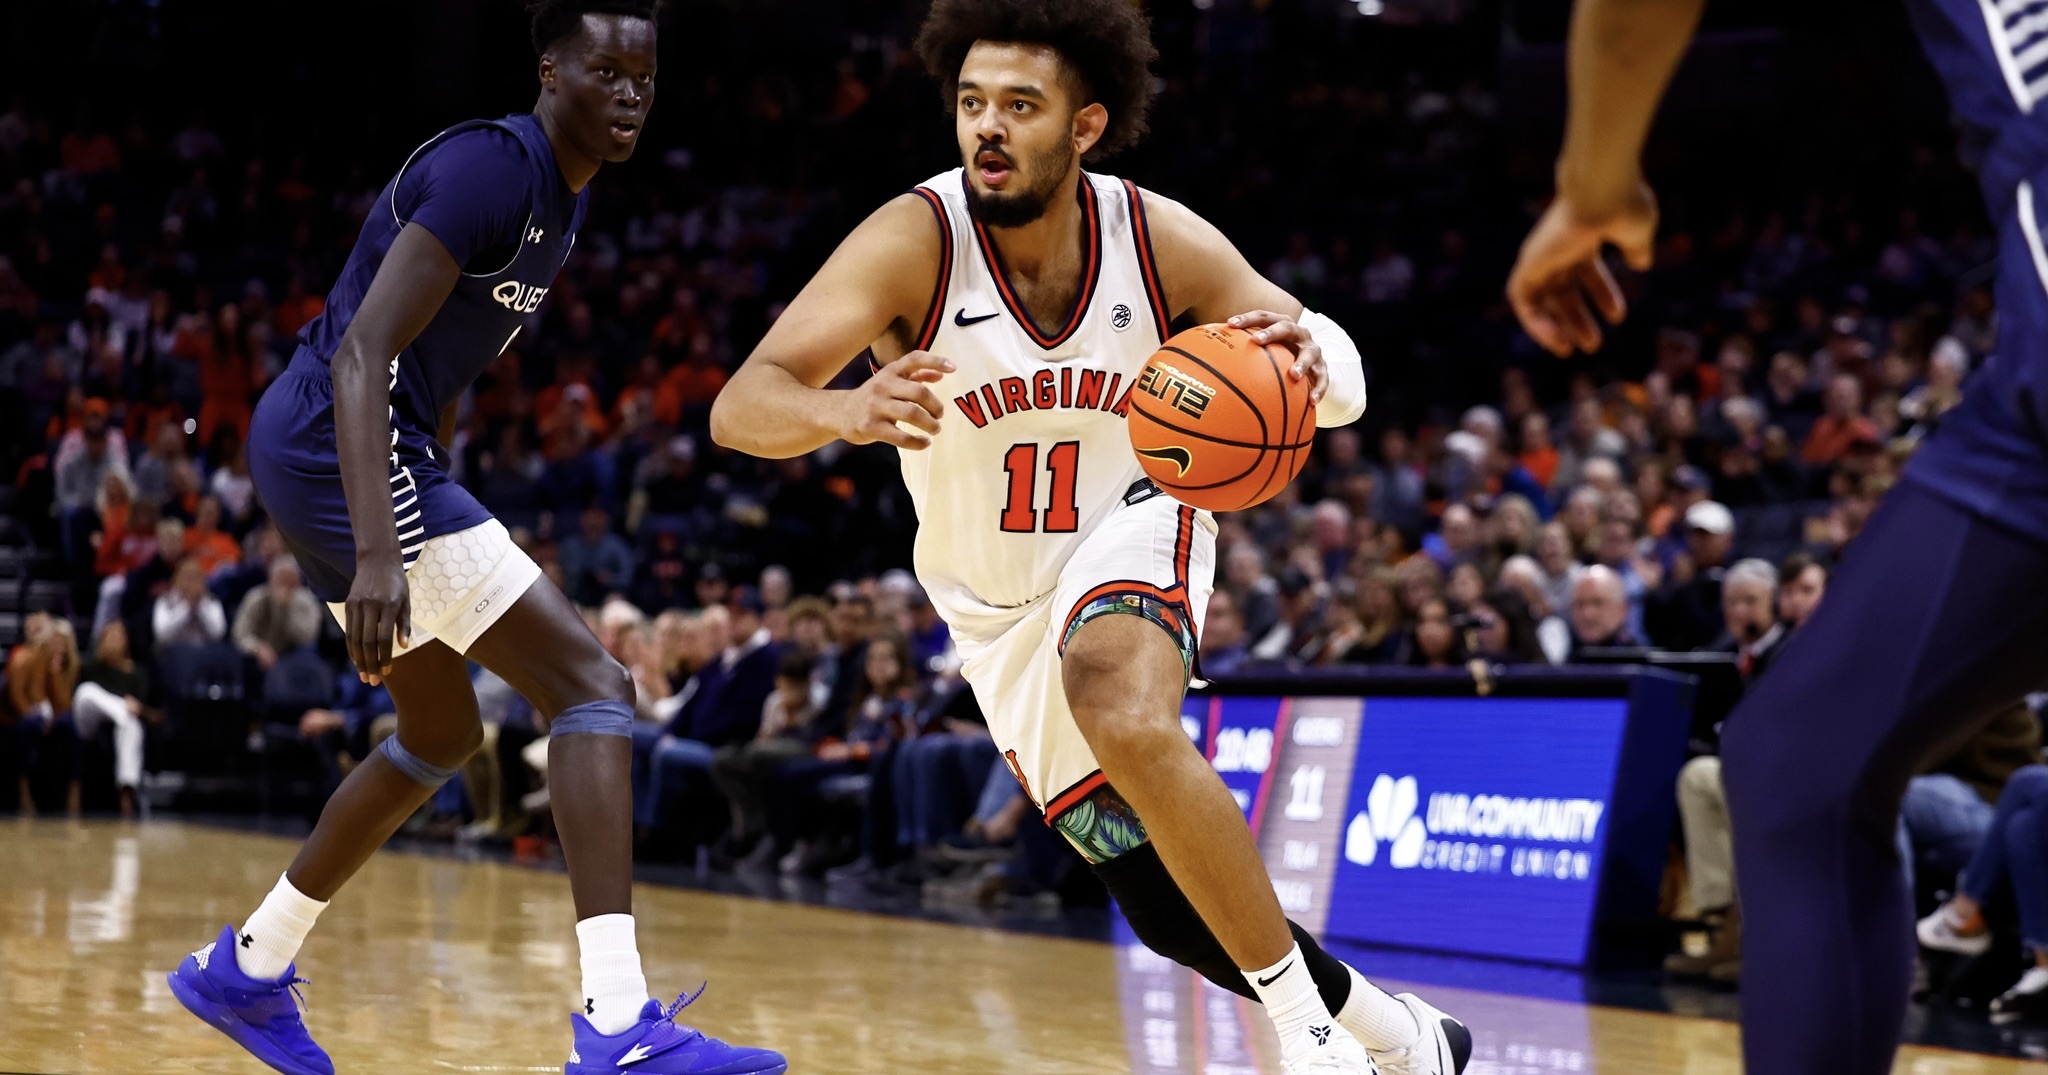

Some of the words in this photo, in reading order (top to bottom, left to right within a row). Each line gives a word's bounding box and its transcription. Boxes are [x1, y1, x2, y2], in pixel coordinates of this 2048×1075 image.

[954, 367, 1137, 429] VIRGINIA
[1137, 365, 1212, 420] ELITE
[1000, 440, 1080, 533] 11
[1285, 764, 1326, 822] 11
[1468, 792, 1605, 844] COMMUNITY
